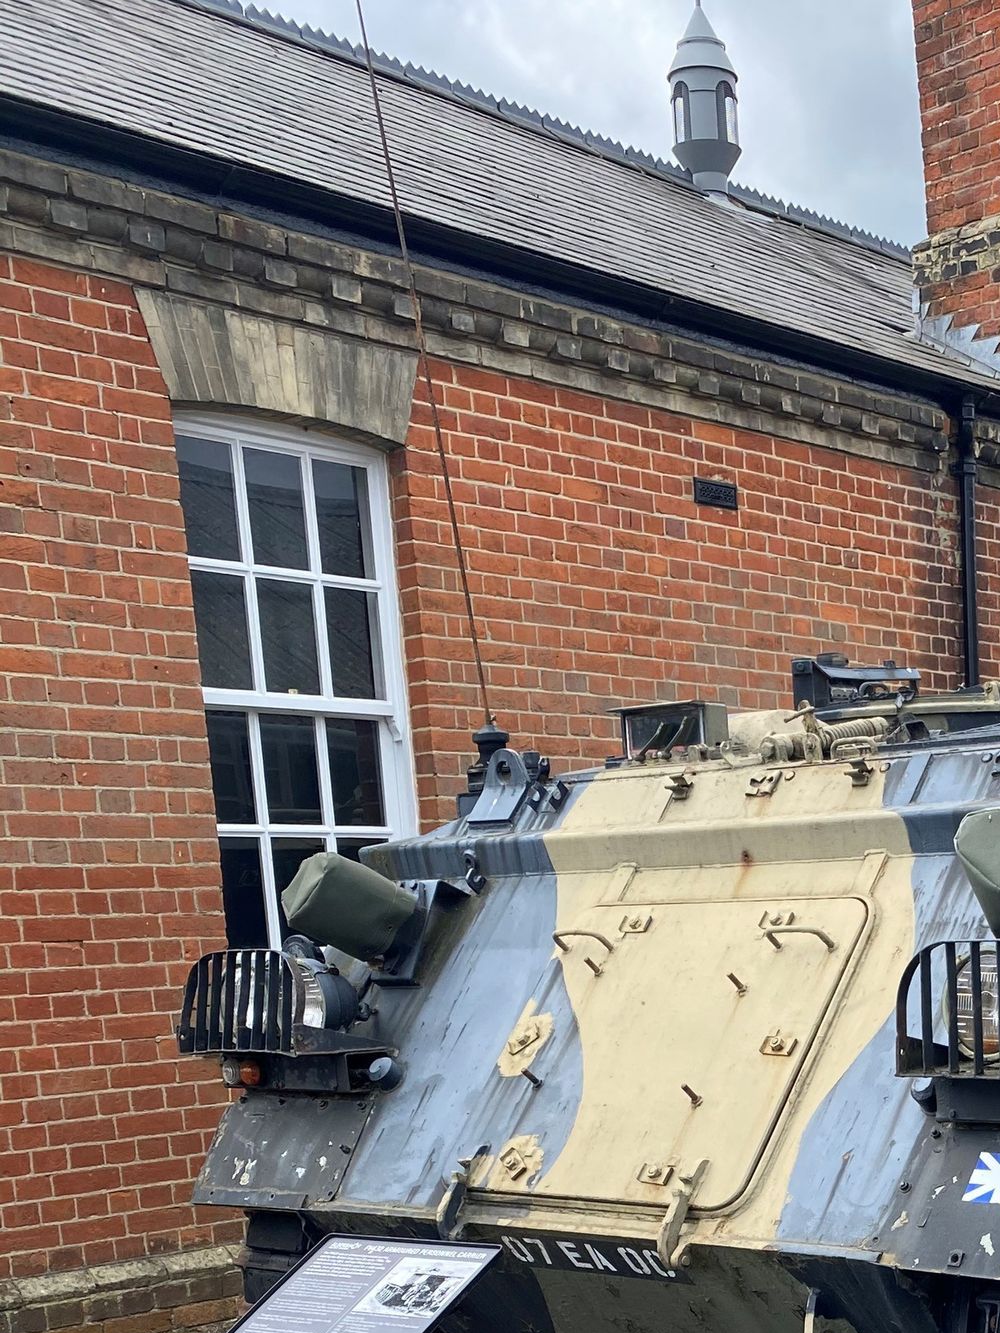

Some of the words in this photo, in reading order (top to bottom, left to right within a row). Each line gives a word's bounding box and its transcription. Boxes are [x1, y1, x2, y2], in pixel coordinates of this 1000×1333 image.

[456, 1251, 487, 1260] CARRIER
[500, 1235, 553, 1265] 07
[555, 1240, 618, 1272] EA
